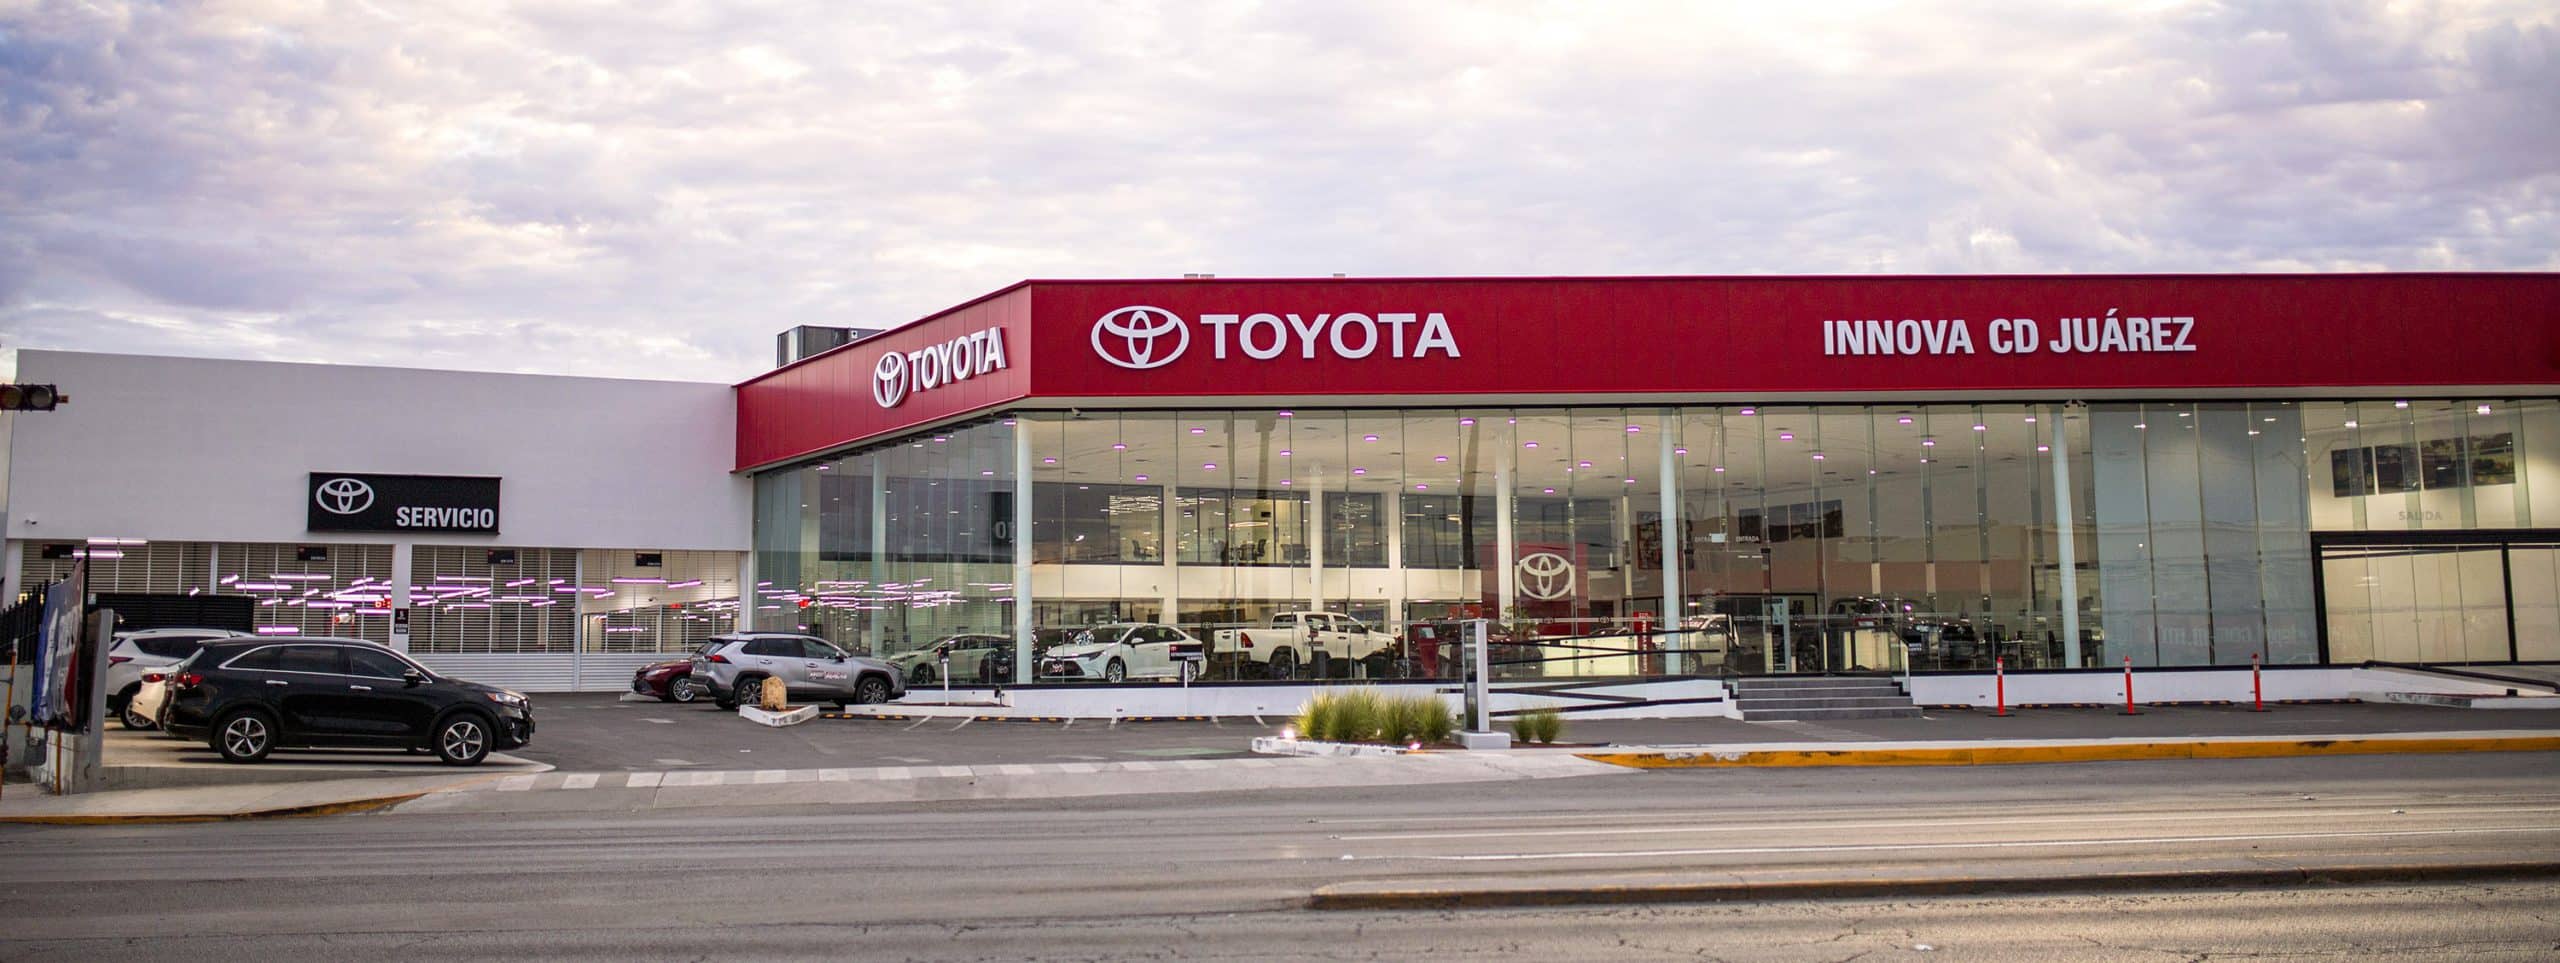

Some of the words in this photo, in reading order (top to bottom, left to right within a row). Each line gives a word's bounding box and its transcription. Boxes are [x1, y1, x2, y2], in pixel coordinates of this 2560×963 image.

[1200, 312, 1461, 359] TOYOTA
[1823, 319, 1975, 354] INNOVA
[1988, 318, 2039, 353] CD
[2049, 308, 2197, 353] JUÁREZ
[908, 326, 1006, 392] TOYOTA
[396, 506, 495, 528] SERVICIO
[2398, 511, 2442, 521] SALIDA
[1735, 535, 1760, 543] ENTRADA
